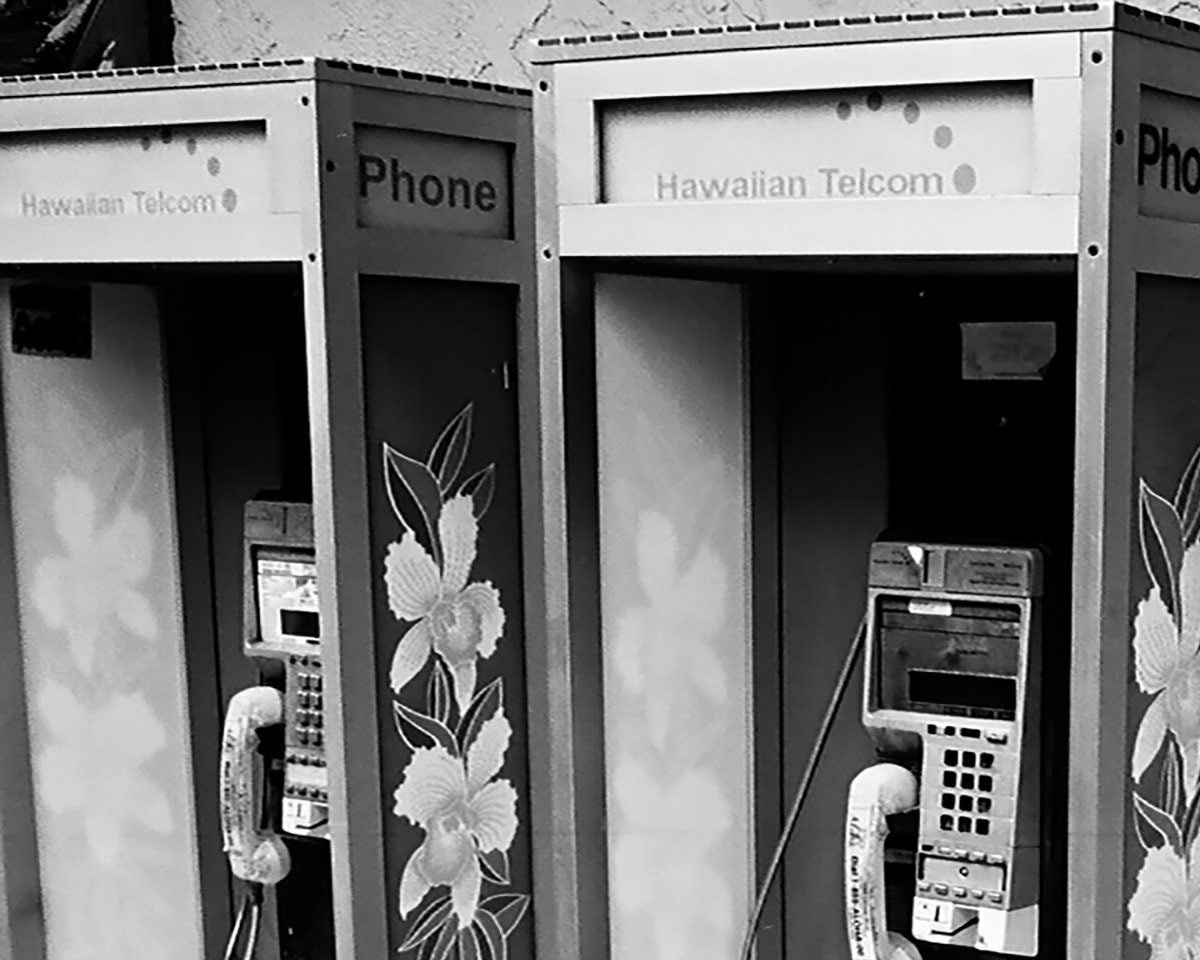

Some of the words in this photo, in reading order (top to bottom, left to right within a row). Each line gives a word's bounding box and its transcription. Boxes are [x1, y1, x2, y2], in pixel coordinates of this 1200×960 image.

[359, 154, 497, 213] Phone
[656, 172, 807, 201] Hawaiian
[818, 168, 943, 195] Telcom
[20, 193, 125, 218] Hawaiian
[132, 190, 217, 214] Telcom
